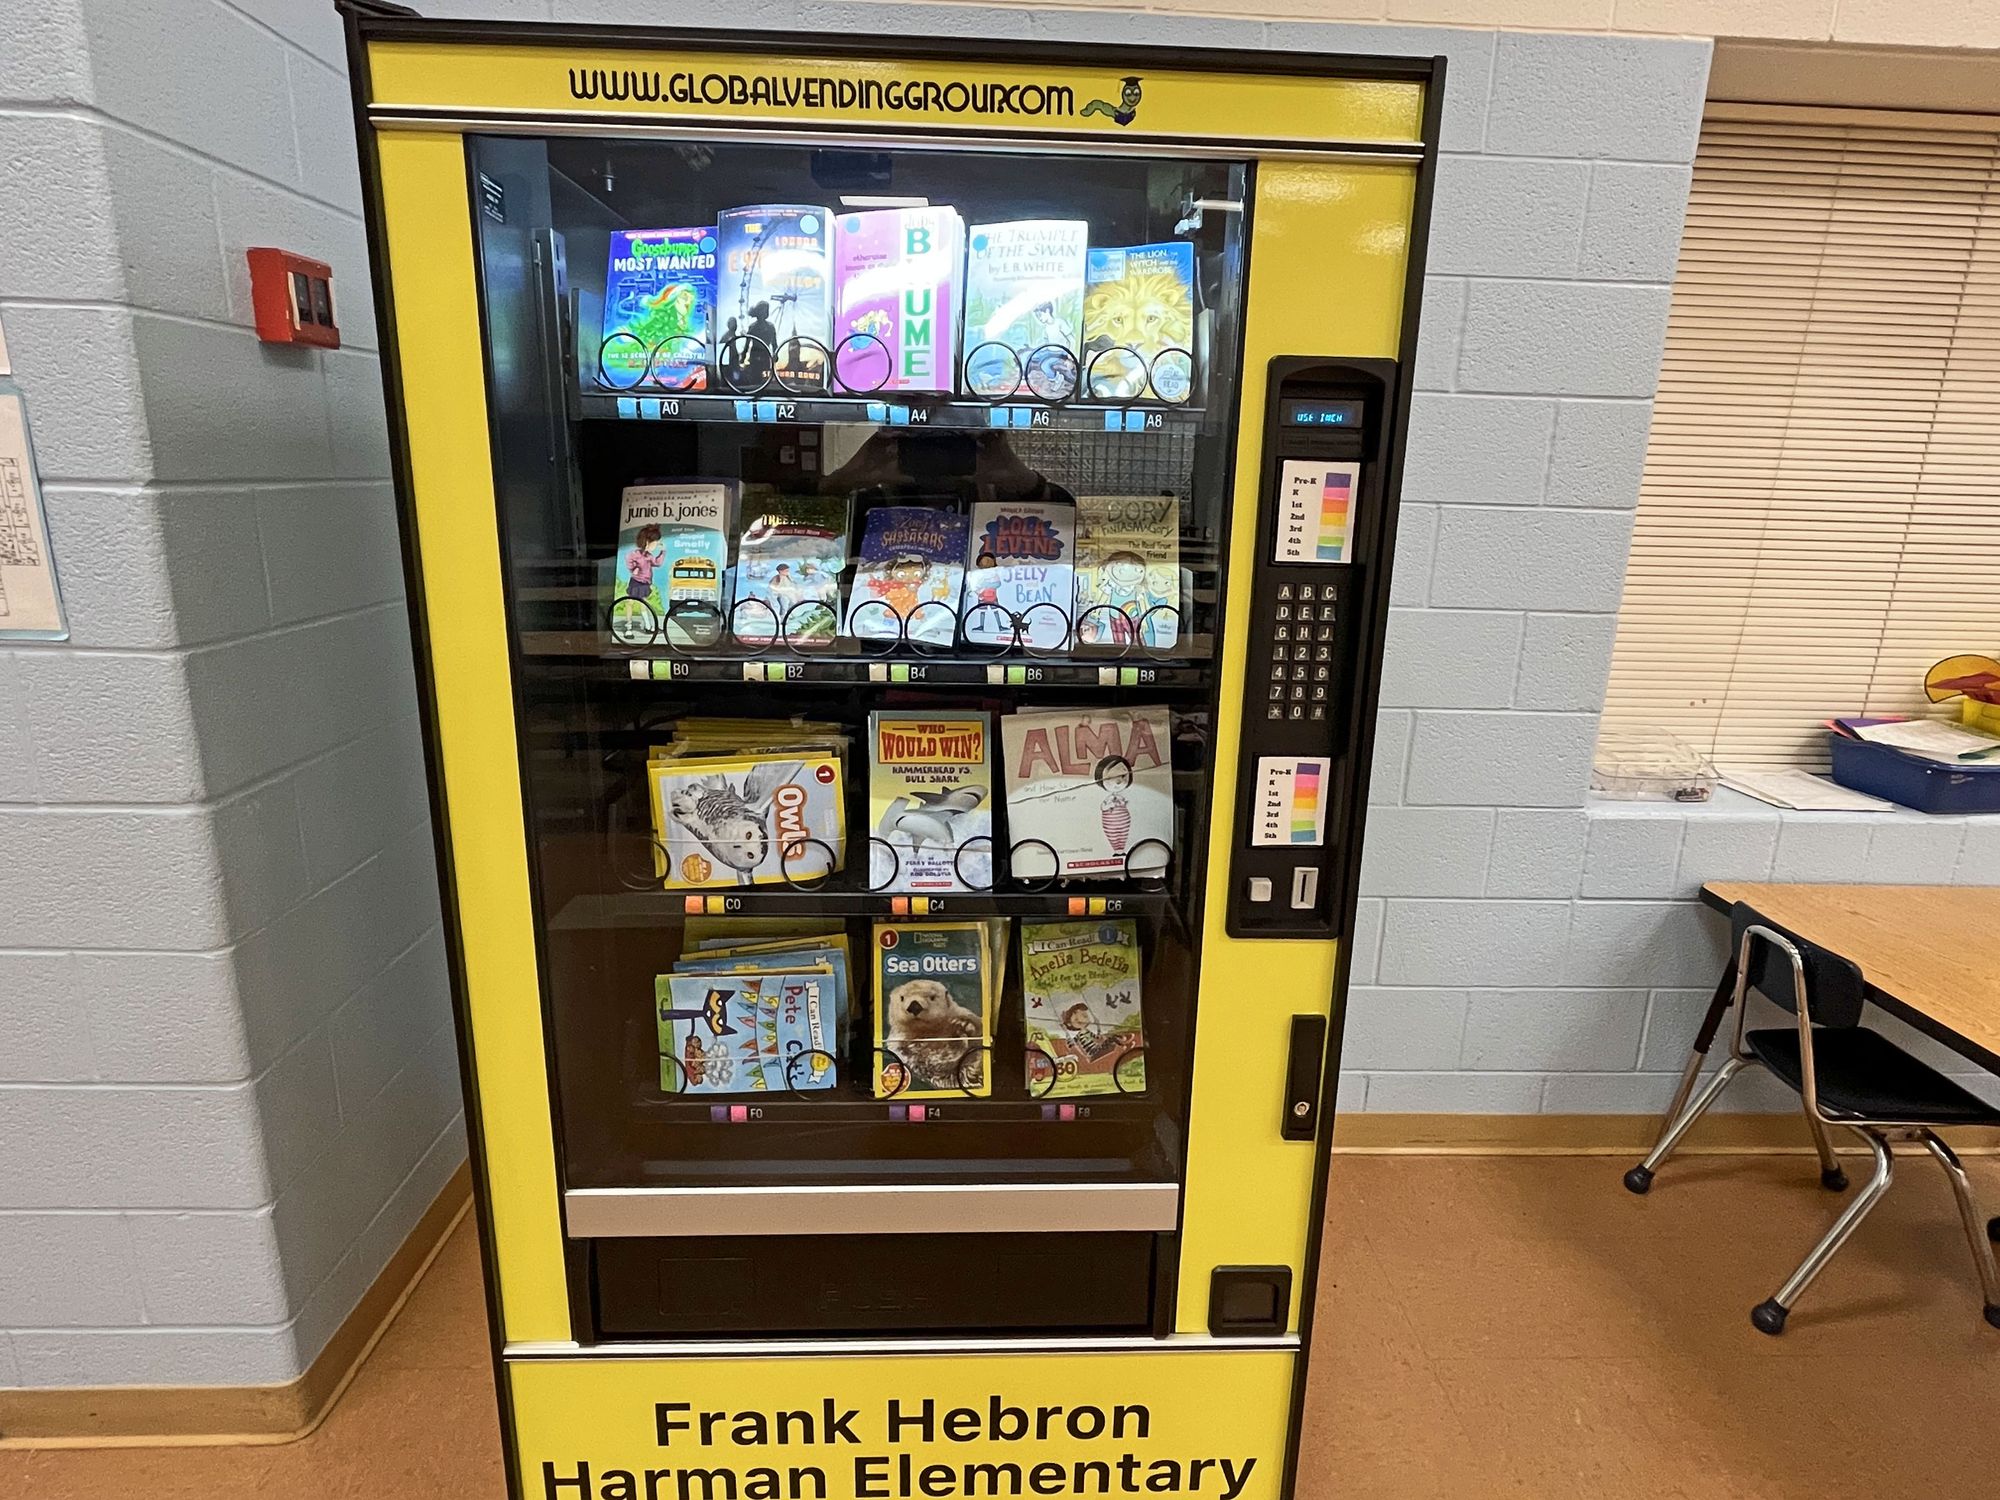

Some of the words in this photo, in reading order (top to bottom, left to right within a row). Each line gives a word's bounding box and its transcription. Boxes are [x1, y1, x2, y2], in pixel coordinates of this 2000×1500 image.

[631, 237, 699, 258] Goosebumps
[999, 245, 1024, 258] THE
[1028, 243, 1078, 257] SWAN
[1130, 252, 1145, 260] THE
[1147, 249, 1167, 259] LION
[614, 257, 653, 272] MOST
[656, 254, 715, 270] WANTED
[1023, 261, 1065, 272] WHITE
[1130, 259, 1157, 268] WITCH
[778, 405, 795, 418] A2
[911, 409, 927, 422] A4
[1297, 413, 1313, 422] USE
[1033, 411, 1049, 426] A6
[1146, 415, 1162, 428] A8
[1294, 477, 1317, 485] Pre-K
[625, 504, 659, 523] junie
[675, 503, 719, 522] jones
[1108, 500, 1172, 523] DORY
[999, 519, 1047, 536] LOLA
[674, 540, 711, 549] Smelly
[881, 530, 946, 552] SASSAFRAS
[984, 535, 1058, 555] LEVINE
[1157, 541, 1172, 549] True
[1146, 551, 1167, 559] Friend
[1003, 567, 1048, 582] JELLY
[1281, 586, 1290, 598] A
[1303, 586, 1312, 599] B
[1325, 586, 1334, 599] C
[1280, 606, 1289, 618] D
[1302, 607, 1310, 619] E
[1324, 607, 1331, 619] F
[1278, 627, 1287, 638] G
[1300, 627, 1309, 639] H
[1322, 627, 1330, 639] J
[1278, 647, 1284, 658] 1
[1299, 647, 1307, 658] 2
[1320, 647, 1328, 659] 3
[788, 665, 804, 678] B2
[911, 667, 926, 679] B4
[1027, 668, 1043, 680] B6
[1140, 670, 1155, 682] B8
[1275, 667, 1283, 678] 4
[1297, 667, 1305, 678] 5
[1318, 667, 1326, 678] 6
[1274, 686, 1282, 697] 7
[1295, 687, 1303, 698] 8
[1316, 687, 1325, 698] 9
[1293, 706, 1301, 717] 0
[917, 724, 946, 734] WHO
[881, 731, 937, 760] WOULD
[939, 732, 981, 760] WIN?
[1018, 718, 1162, 778] ALMA
[892, 766, 955, 774] HAMMERHEAD
[958, 766, 973, 775] VS.
[905, 775, 926, 783] BULL
[930, 775, 960, 783] SHARK
[777, 787, 807, 856] Owls
[930, 900, 945, 911] C4
[1107, 900, 1122, 911] C6
[884, 933, 892, 945] 1
[1047, 941, 1067, 950] Can
[886, 956, 920, 973] Sea
[922, 955, 977, 972] Otters
[1029, 952, 1074, 981] Amelia
[1079, 948, 1130, 974] Bedelia
[1074, 972, 1086, 981] the
[785, 986, 804, 1025] Pete
[809, 1000, 819, 1021] Can
[928, 1108, 941, 1118] F4
[655, 1398, 862, 1447] Frank
[887, 1395, 1151, 1443] Hebron
[542, 1460, 827, 1500] Harman
[854, 1453, 1258, 1500] Elementary
